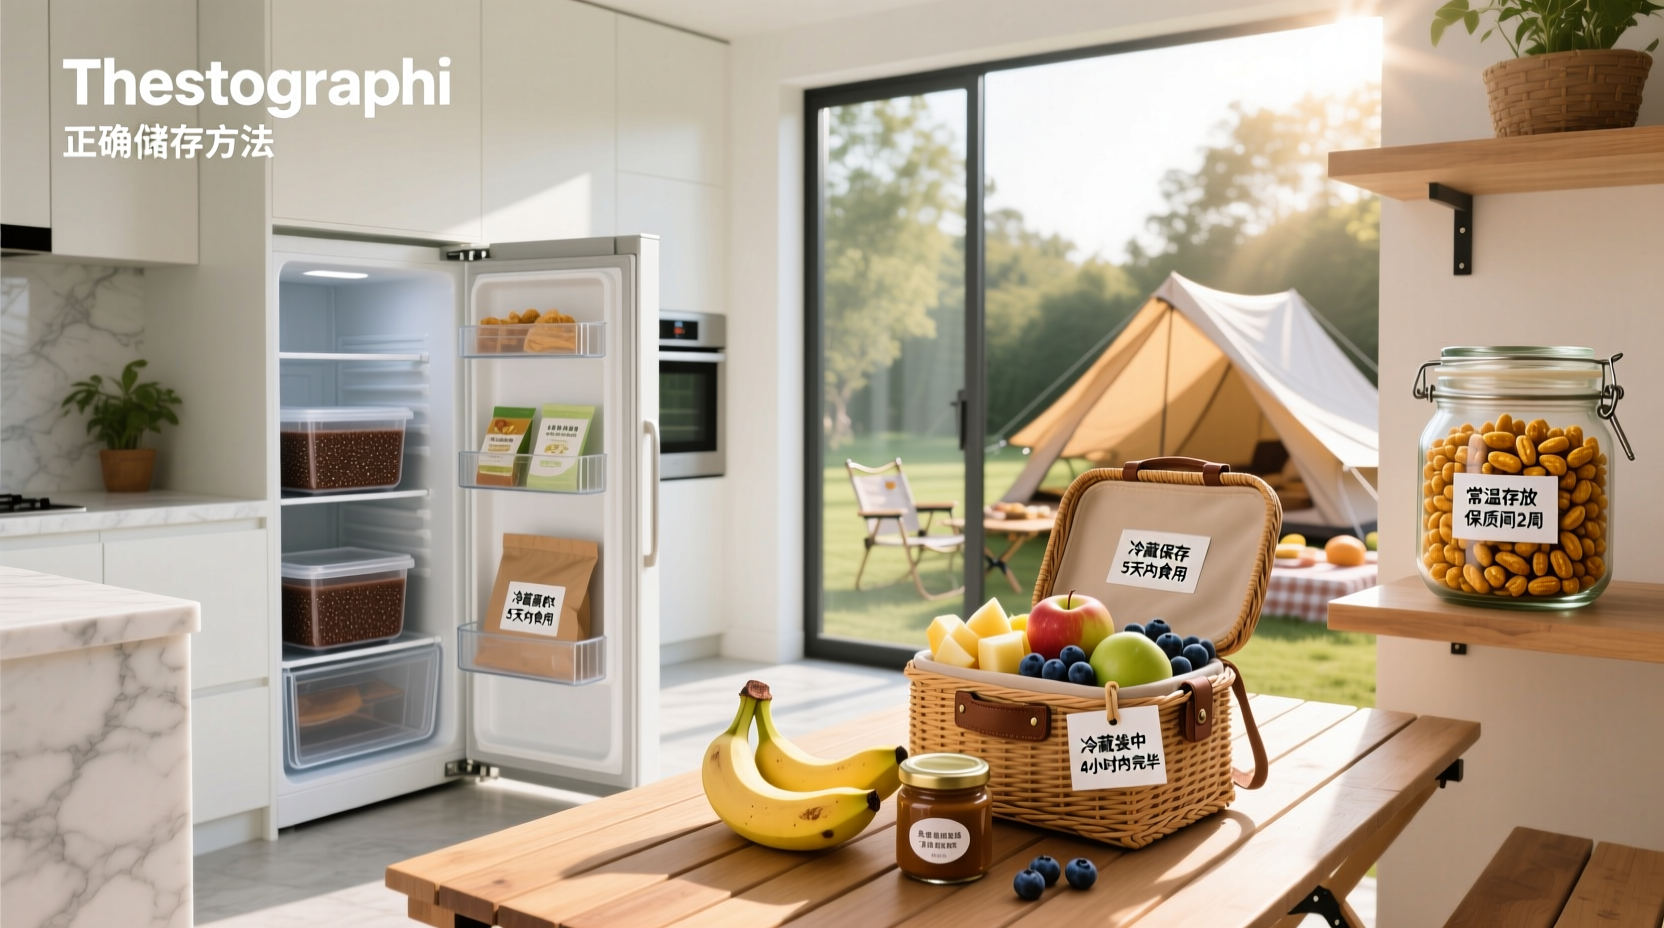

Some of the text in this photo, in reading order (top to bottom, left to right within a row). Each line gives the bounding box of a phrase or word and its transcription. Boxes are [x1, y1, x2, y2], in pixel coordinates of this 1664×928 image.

[1466, 486, 1538, 507] 常温存放
[1128, 540, 1191, 562] 冷藏保存
[1120, 561, 1188, 582] 5天内食用
[1080, 753, 1161, 775] 4小时内完毕
